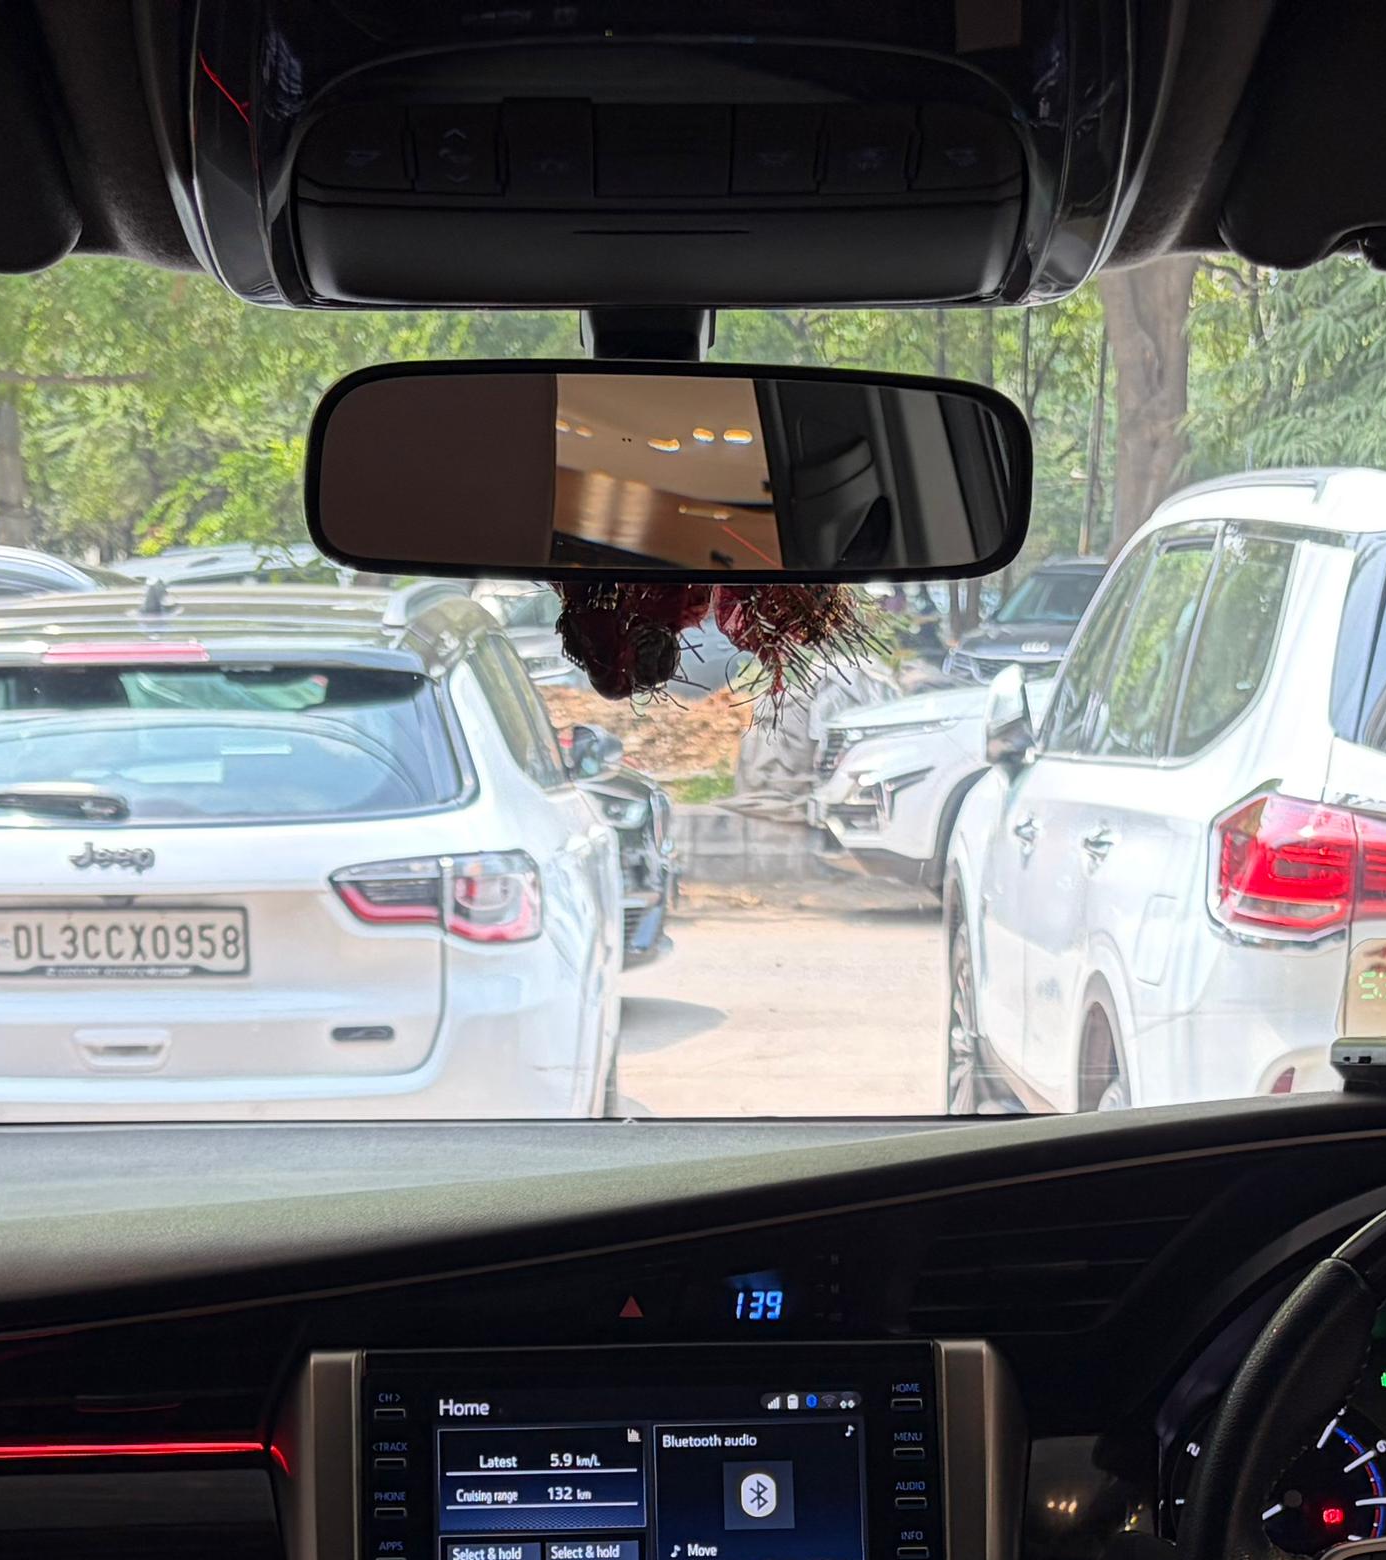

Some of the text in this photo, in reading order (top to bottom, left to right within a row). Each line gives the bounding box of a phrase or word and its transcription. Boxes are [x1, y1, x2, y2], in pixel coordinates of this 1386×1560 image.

[69, 842, 155, 875] Jeep
[13, 924, 241, 961] DL3CCX0958
[892, 1384, 920, 1392] HOME
[439, 1399, 491, 1417] Home
[662, 1433, 757, 1448] Bluetooth audio
[894, 1432, 922, 1441] MENU
[1186, 1441, 1201, 1458] 2
[479, 1453, 601, 1468] Latest 5.9 km/L
[895, 1481, 926, 1490] AUDIO
[374, 1492, 406, 1501] PHONE
[456, 1487, 592, 1504] Cruising range 132 km
[901, 1532, 923, 1540] INFO
[379, 1542, 403, 1550] APPS
[551, 1545, 620, 1559] Select & hold
[687, 1544, 717, 1557] Move
[453, 1547, 522, 1560] Select & hold
